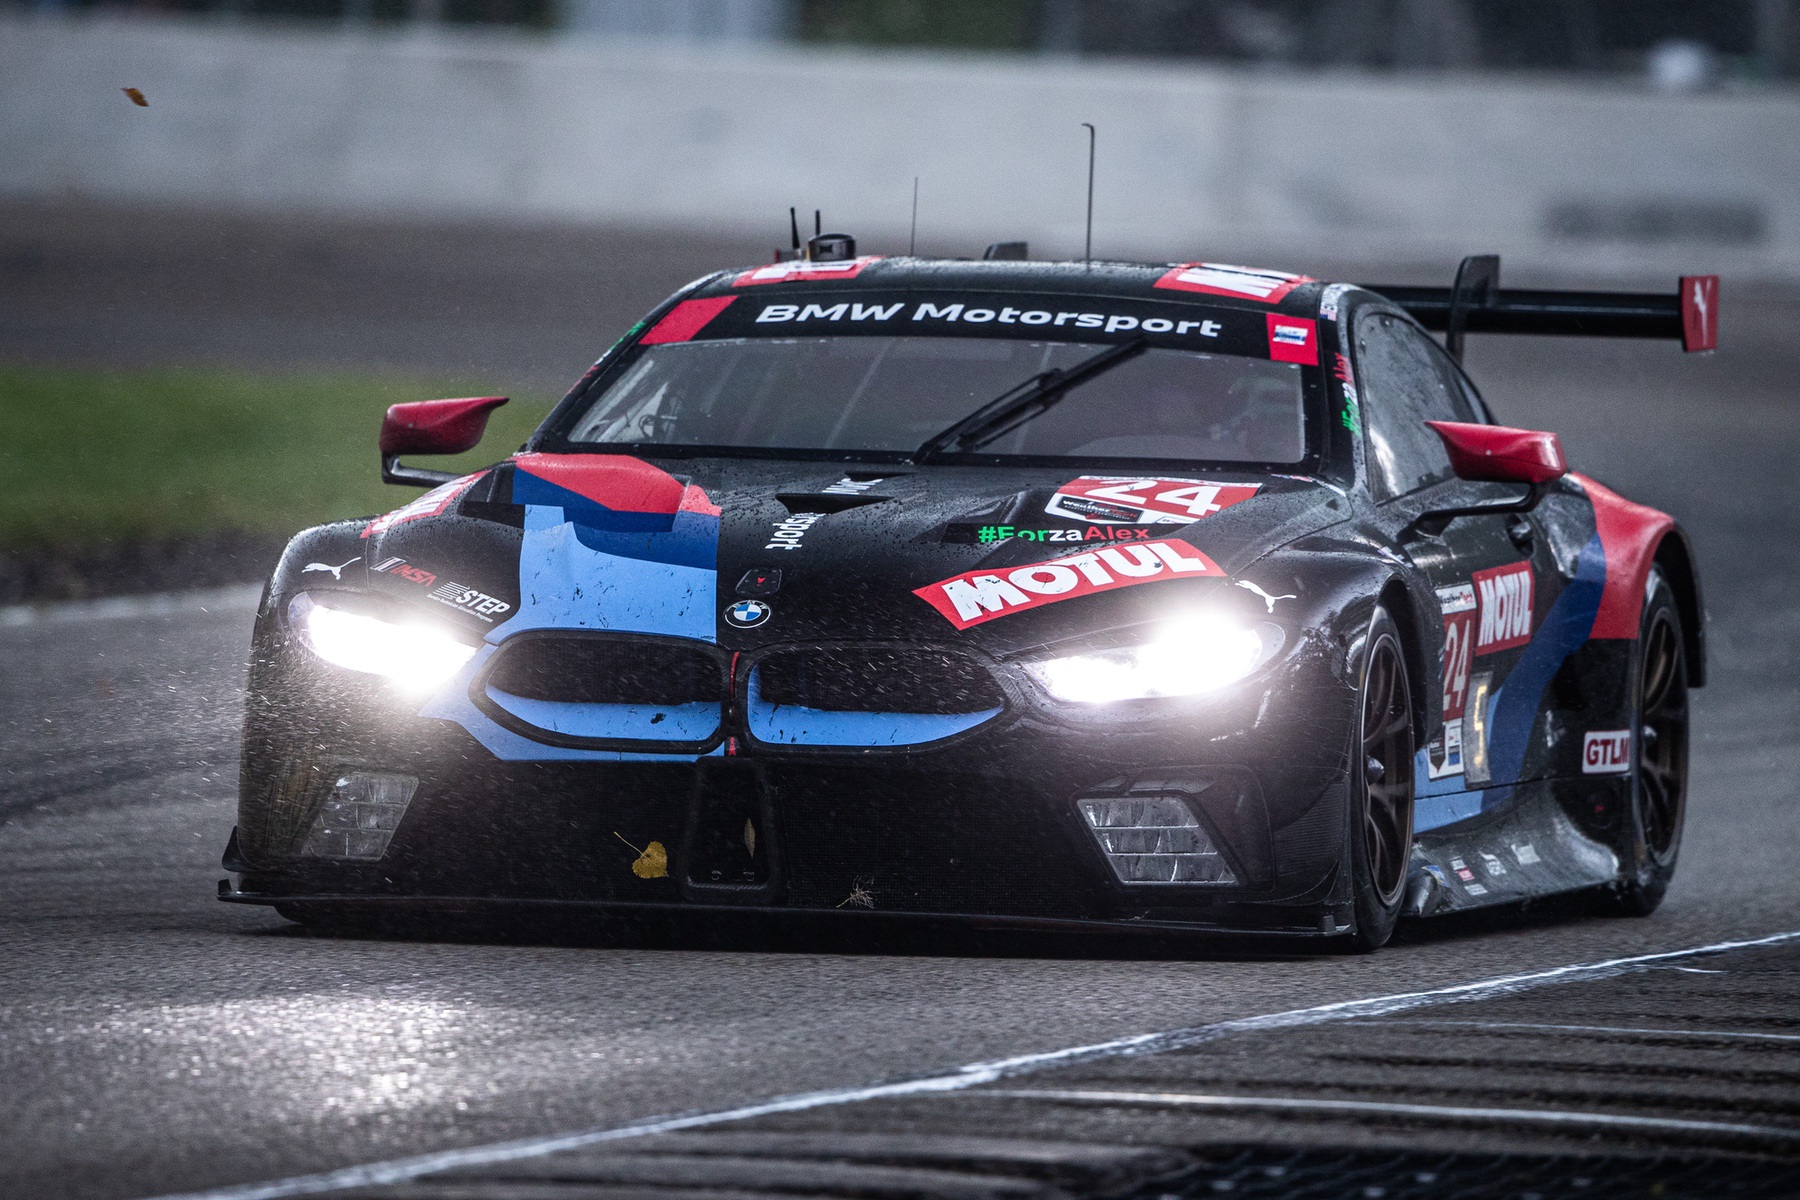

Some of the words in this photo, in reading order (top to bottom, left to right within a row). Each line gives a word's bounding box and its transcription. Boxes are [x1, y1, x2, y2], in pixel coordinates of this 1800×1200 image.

[756, 302, 904, 324] BMW
[911, 303, 1222, 337] Motorsport
[1083, 479, 1222, 516] 24
[977, 525, 1150, 543] #ForzaAlex
[941, 542, 1207, 622] MOTUL
[455, 590, 511, 615] STEP
[1477, 570, 1531, 647] MOTUL
[1442, 619, 1471, 711] 24
